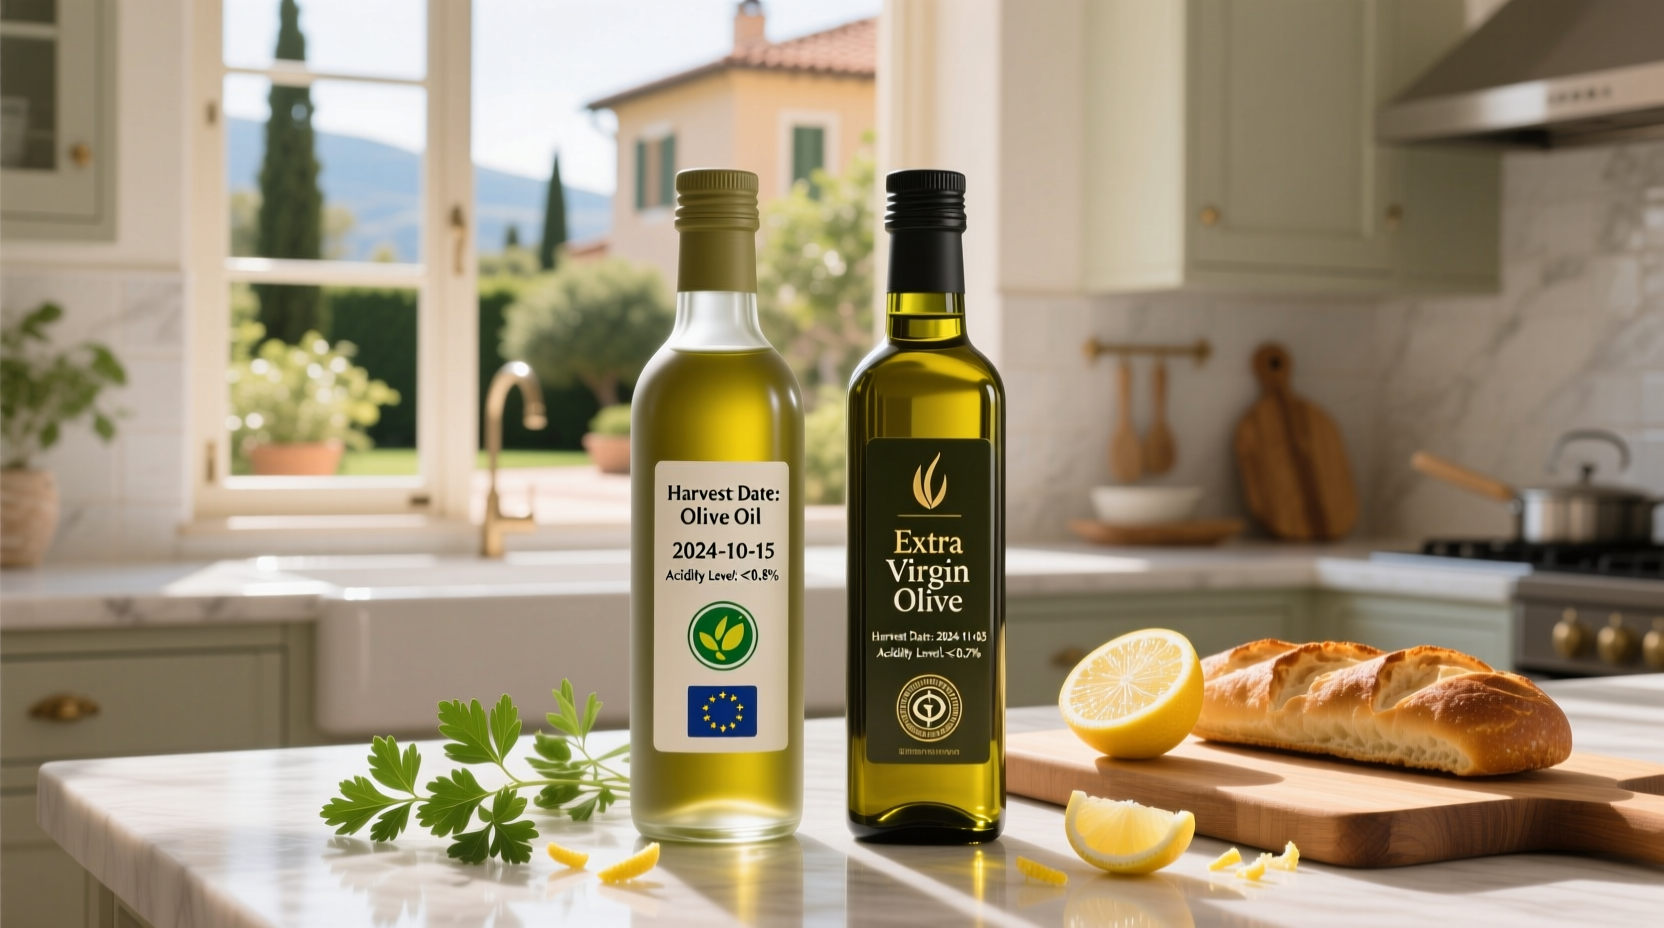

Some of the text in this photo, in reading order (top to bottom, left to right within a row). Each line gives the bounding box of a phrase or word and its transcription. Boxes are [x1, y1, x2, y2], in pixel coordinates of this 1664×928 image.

[667, 485, 780, 501] Harvest Date:
[680, 506, 761, 525] Olive Oil
[672, 541, 775, 559] 2024-10-15
[893, 529, 964, 554] Extra
[740, 568, 779, 581] <0.8%
[885, 558, 970, 590] Virgin
[893, 587, 963, 612] Olive
